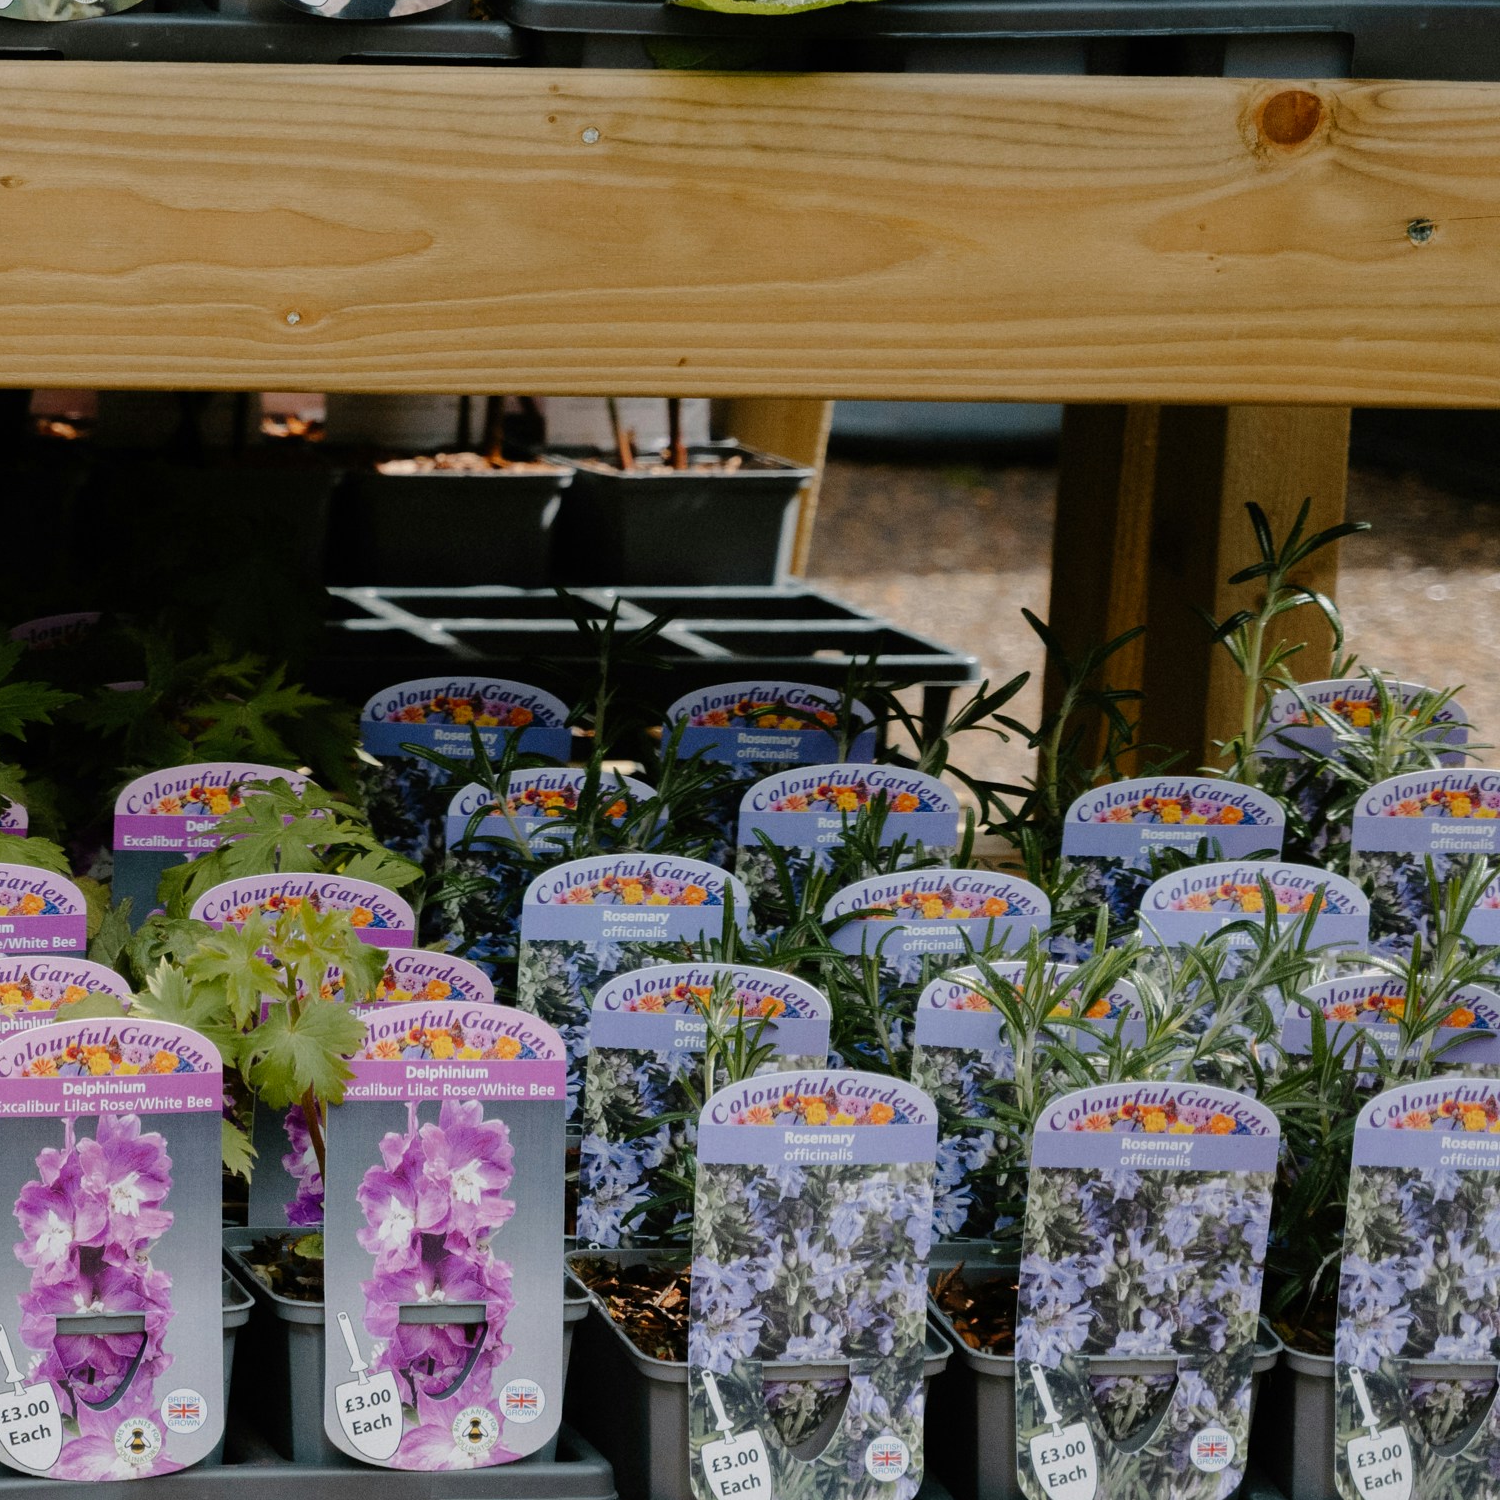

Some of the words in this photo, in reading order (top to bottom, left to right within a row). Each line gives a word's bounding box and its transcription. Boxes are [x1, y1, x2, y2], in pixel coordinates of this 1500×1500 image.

[711, 1077, 831, 1124] Colourful
[836, 1078, 927, 1124] Gardens
[784, 1131, 856, 1146] Rosemary
[784, 1149, 854, 1161] officinalis
[711, 1448, 759, 1473] £3.00
[720, 1474, 762, 1496] Each
